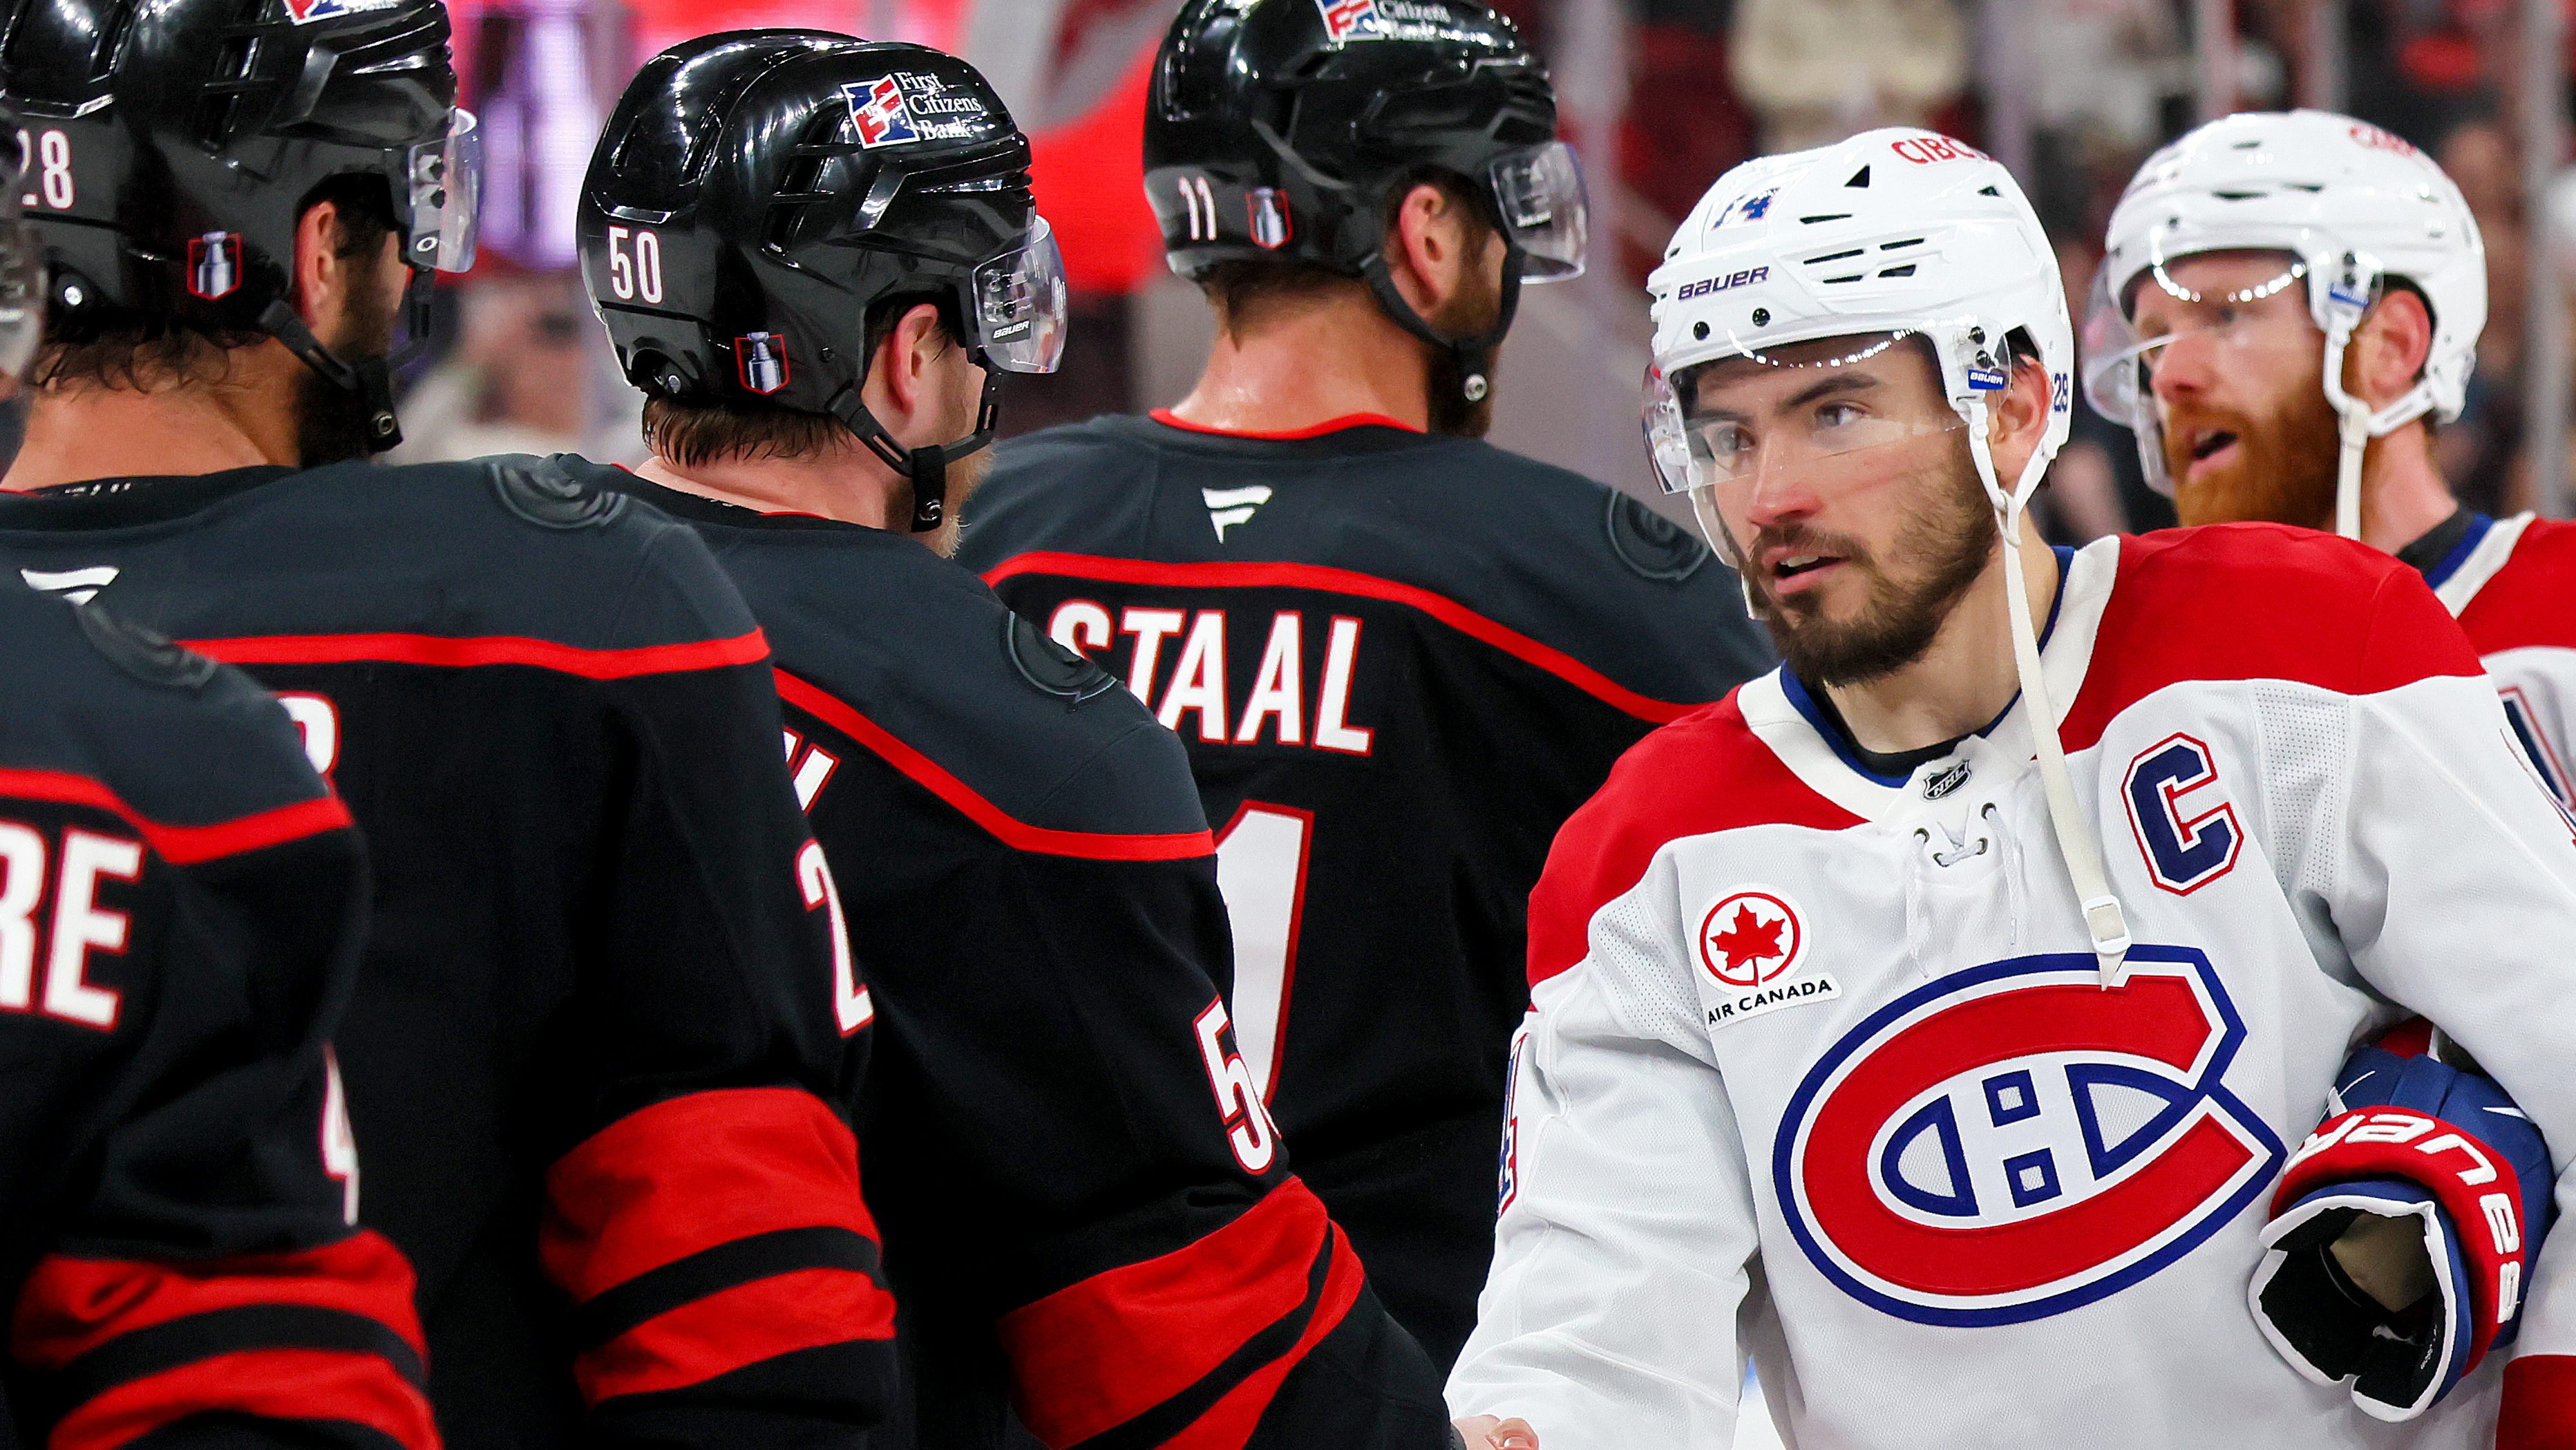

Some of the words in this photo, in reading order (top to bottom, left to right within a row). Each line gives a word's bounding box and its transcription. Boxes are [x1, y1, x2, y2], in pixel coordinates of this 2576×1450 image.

[895, 72, 943, 91] First
[909, 94, 982, 115] Citizens
[1891, 137, 1976, 164] CIBC
[1177, 176, 1218, 241] 11
[608, 225, 665, 305] 50
[1678, 265, 1770, 301] BAUER
[993, 320, 1030, 339] BAUER
[1969, 371, 2004, 386] BAUER
[2121, 731, 2244, 897] C
[0, 820, 145, 1035] RE
[1708, 1003, 1736, 1026] AIR
[1739, 979, 1832, 1012] CANADA
[1192, 993, 1282, 1176] 5
[2284, 1113, 2521, 1324] BAUER
